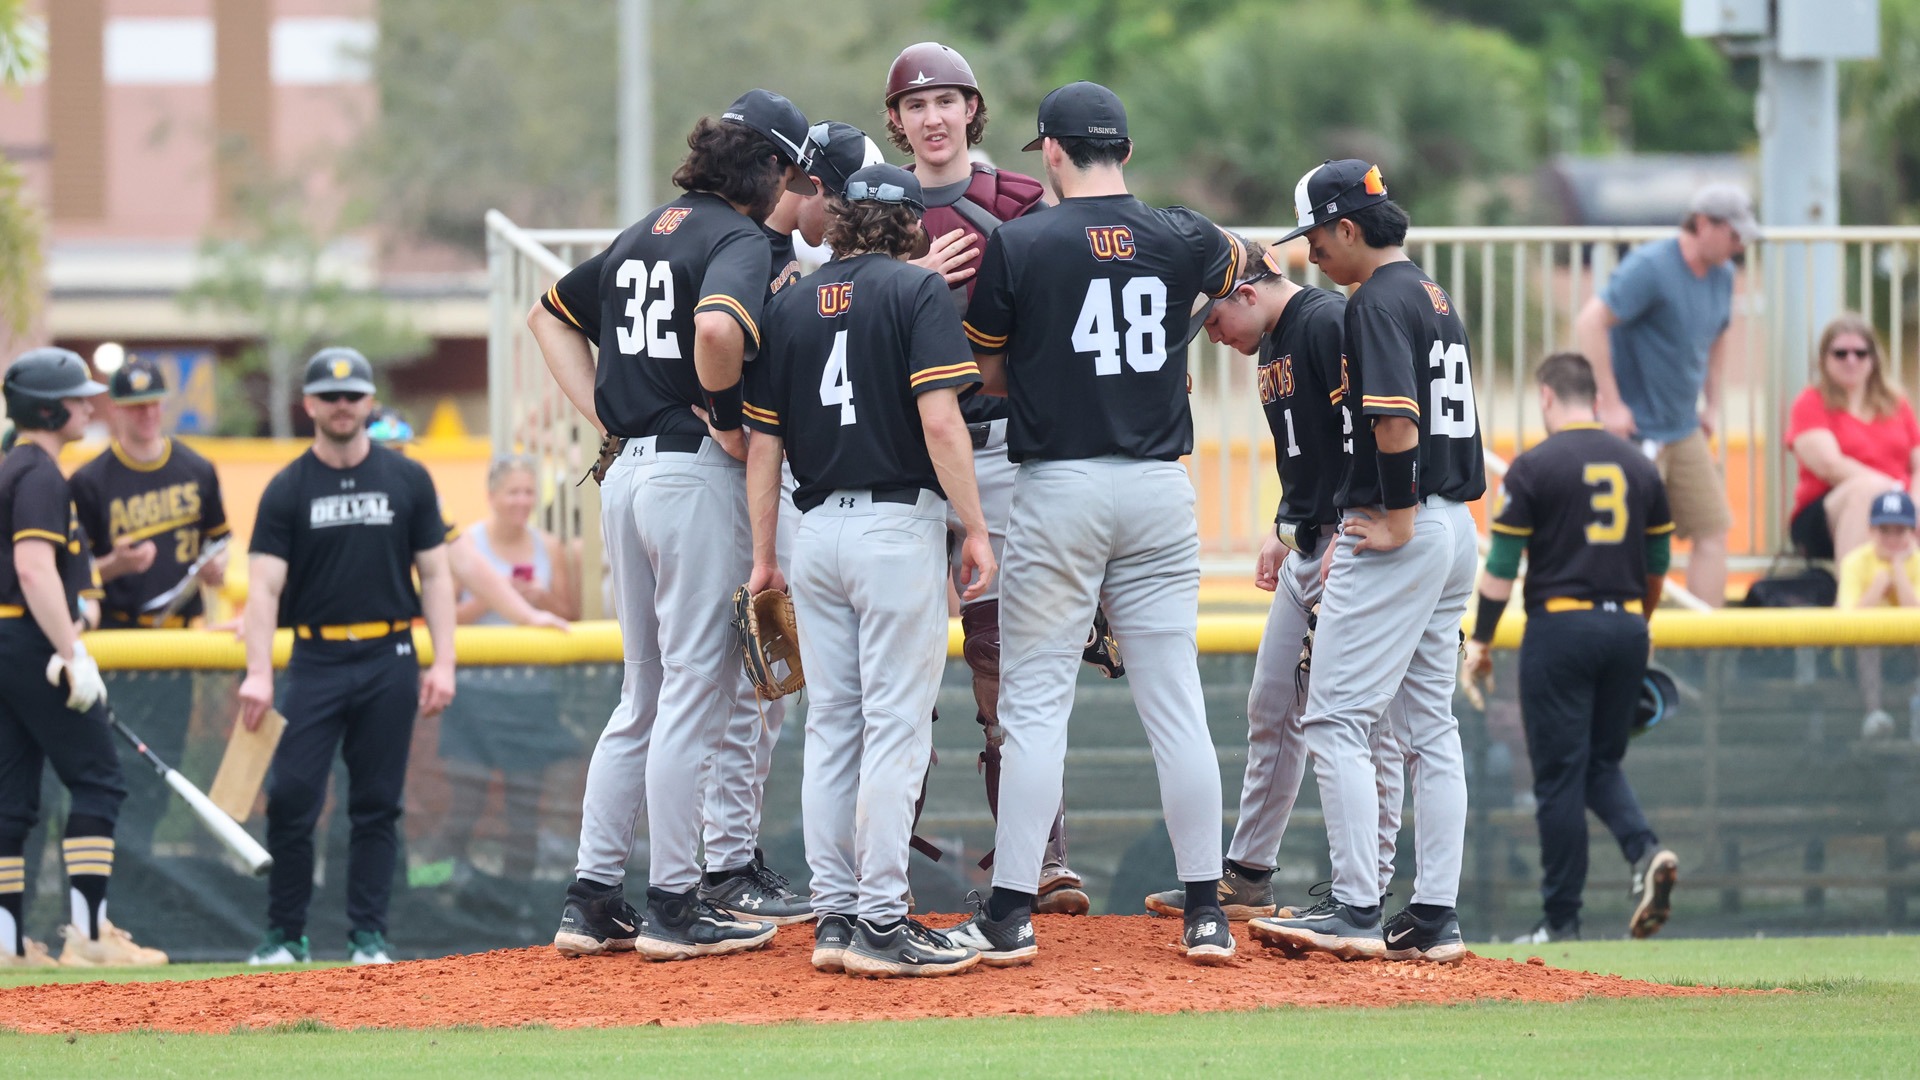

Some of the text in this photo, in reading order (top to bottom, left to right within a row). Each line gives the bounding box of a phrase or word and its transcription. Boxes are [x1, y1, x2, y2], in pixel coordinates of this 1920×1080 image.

[1088, 126, 1118, 134] URSINUS
[652, 207, 692, 235] UC
[1085, 225, 1136, 261] UC
[616, 259, 682, 359] 32
[817, 281, 853, 318] UC
[1419, 280, 1449, 315] UC
[1071, 276, 1167, 376] 48
[819, 329, 856, 426] 4
[1429, 339, 1476, 438] 29
[1284, 408, 1301, 457] 1
[109, 481, 201, 544] AGGIES
[310, 498, 395, 524] DELVAL
[1583, 463, 1629, 545] 3
[174, 527, 199, 563] 21
